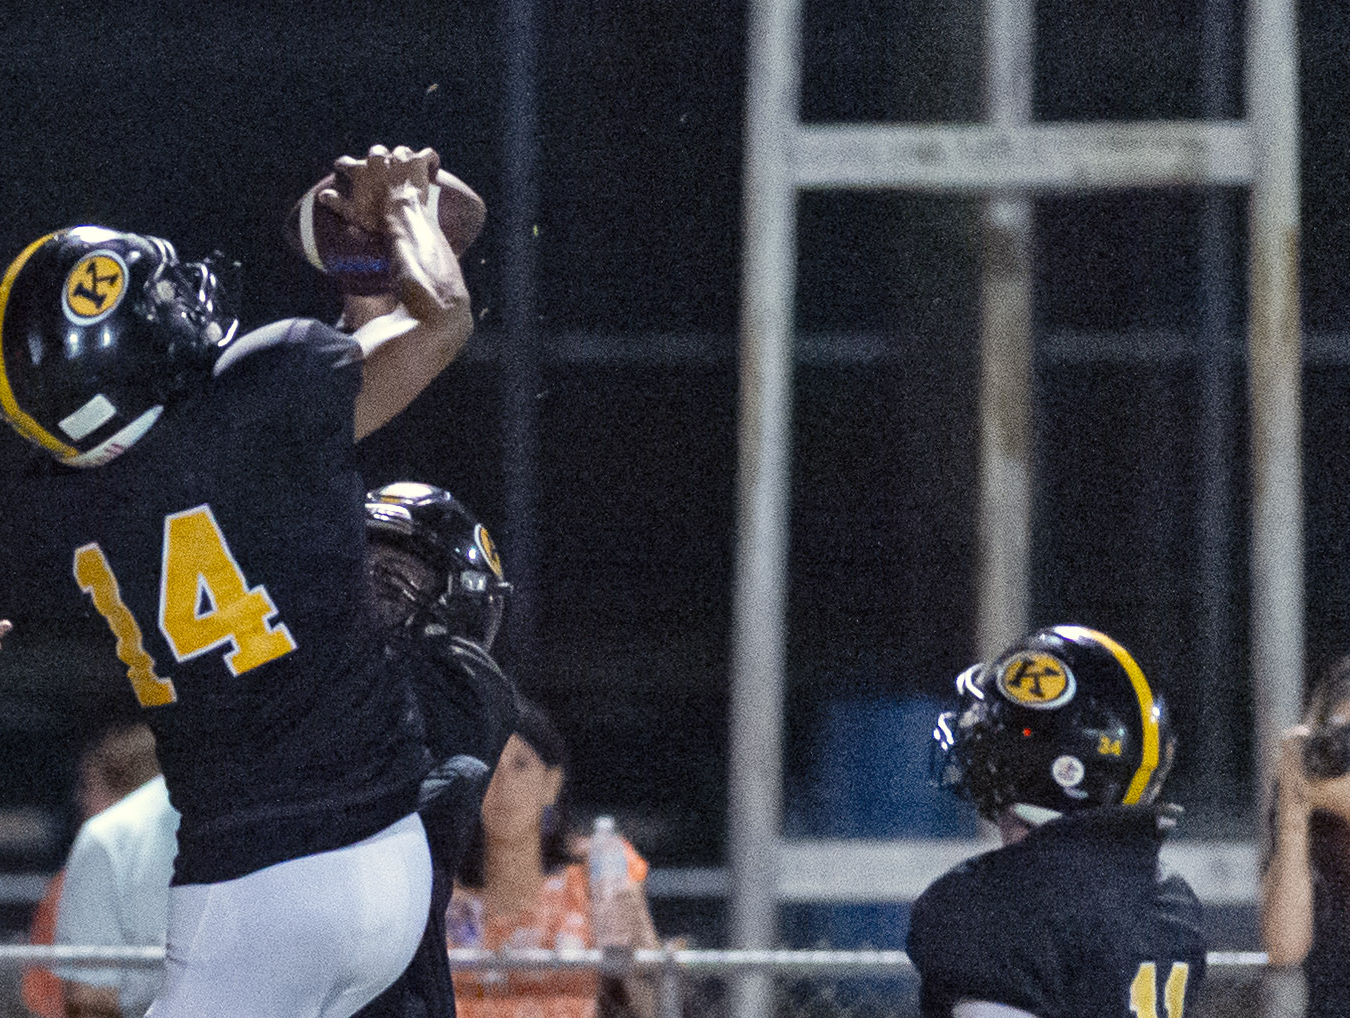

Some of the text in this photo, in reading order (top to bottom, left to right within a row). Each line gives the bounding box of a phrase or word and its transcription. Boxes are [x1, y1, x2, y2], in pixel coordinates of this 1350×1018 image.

[73, 261, 120, 310] K
[73, 504, 297, 706] 14
[1009, 660, 1061, 698] K
